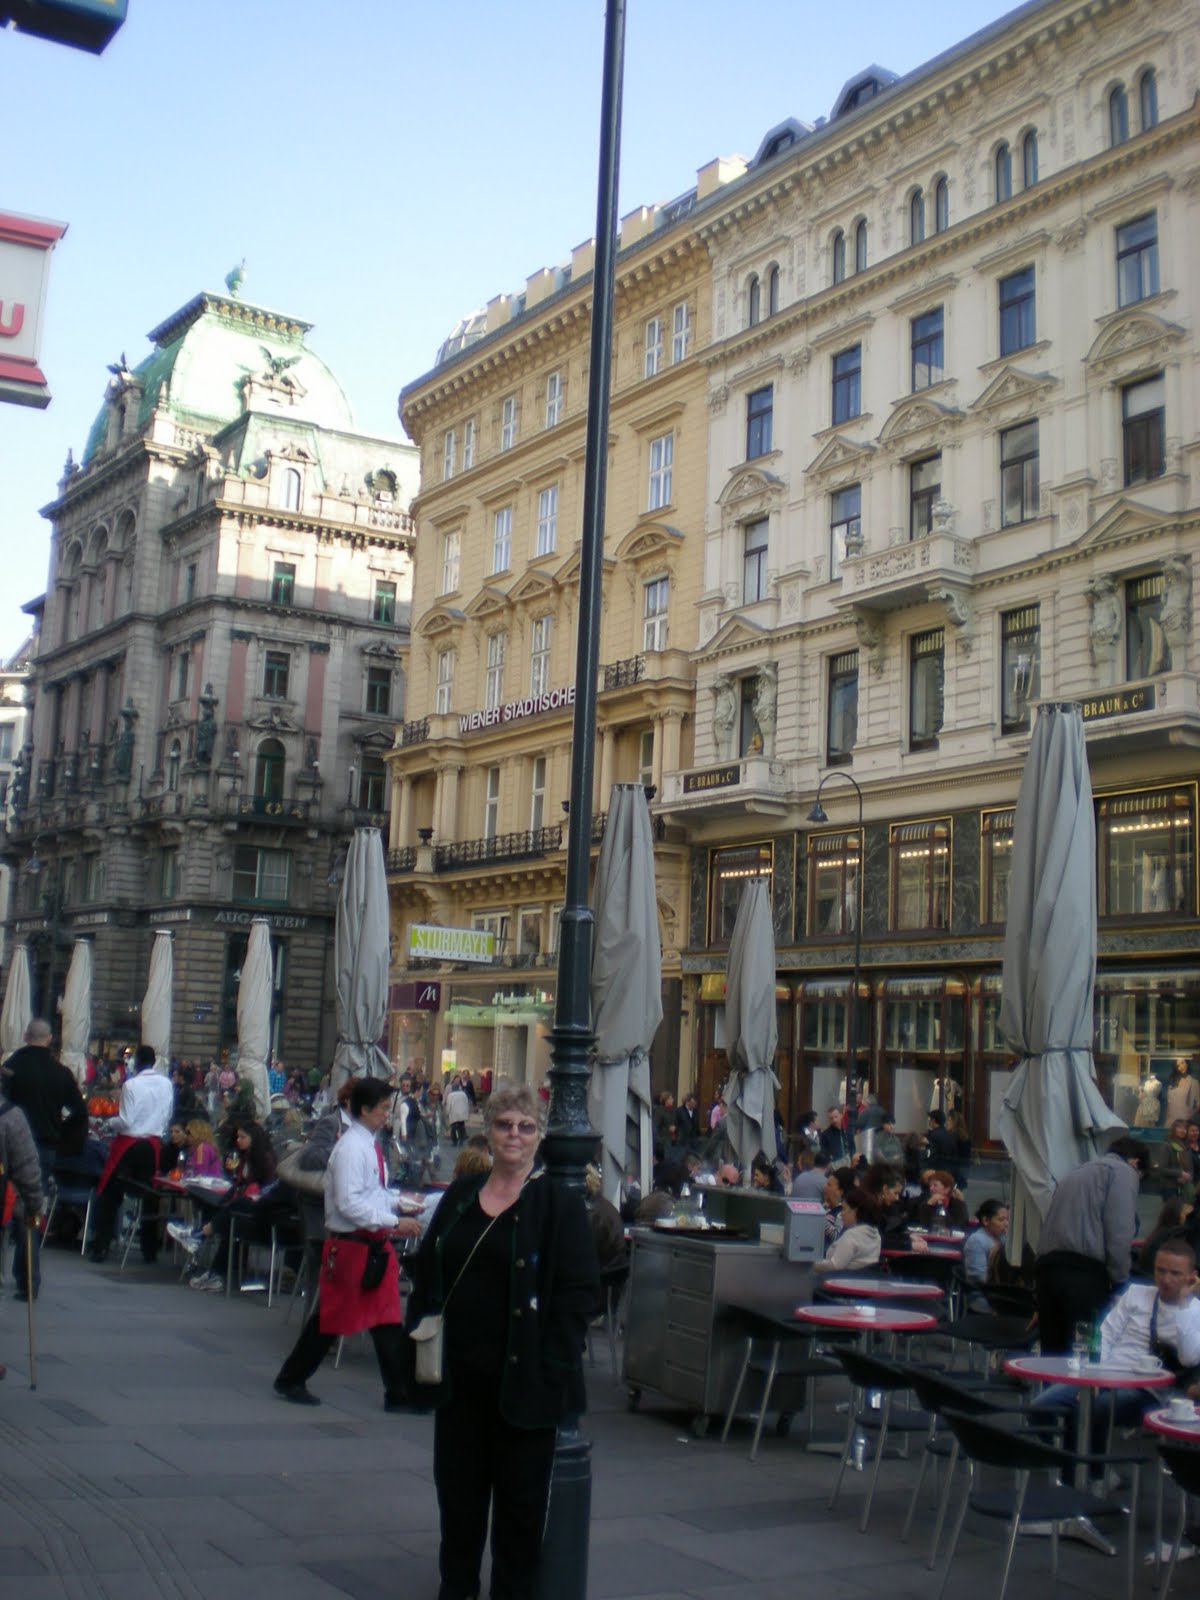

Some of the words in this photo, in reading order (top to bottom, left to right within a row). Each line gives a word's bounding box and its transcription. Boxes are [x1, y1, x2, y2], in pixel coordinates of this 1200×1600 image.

[1084, 697, 1120, 717] BRAUN
[460, 707, 500, 732] WIENER
[697, 773, 720, 787] BRAUN
[416, 927, 489, 955] STURMAYR
